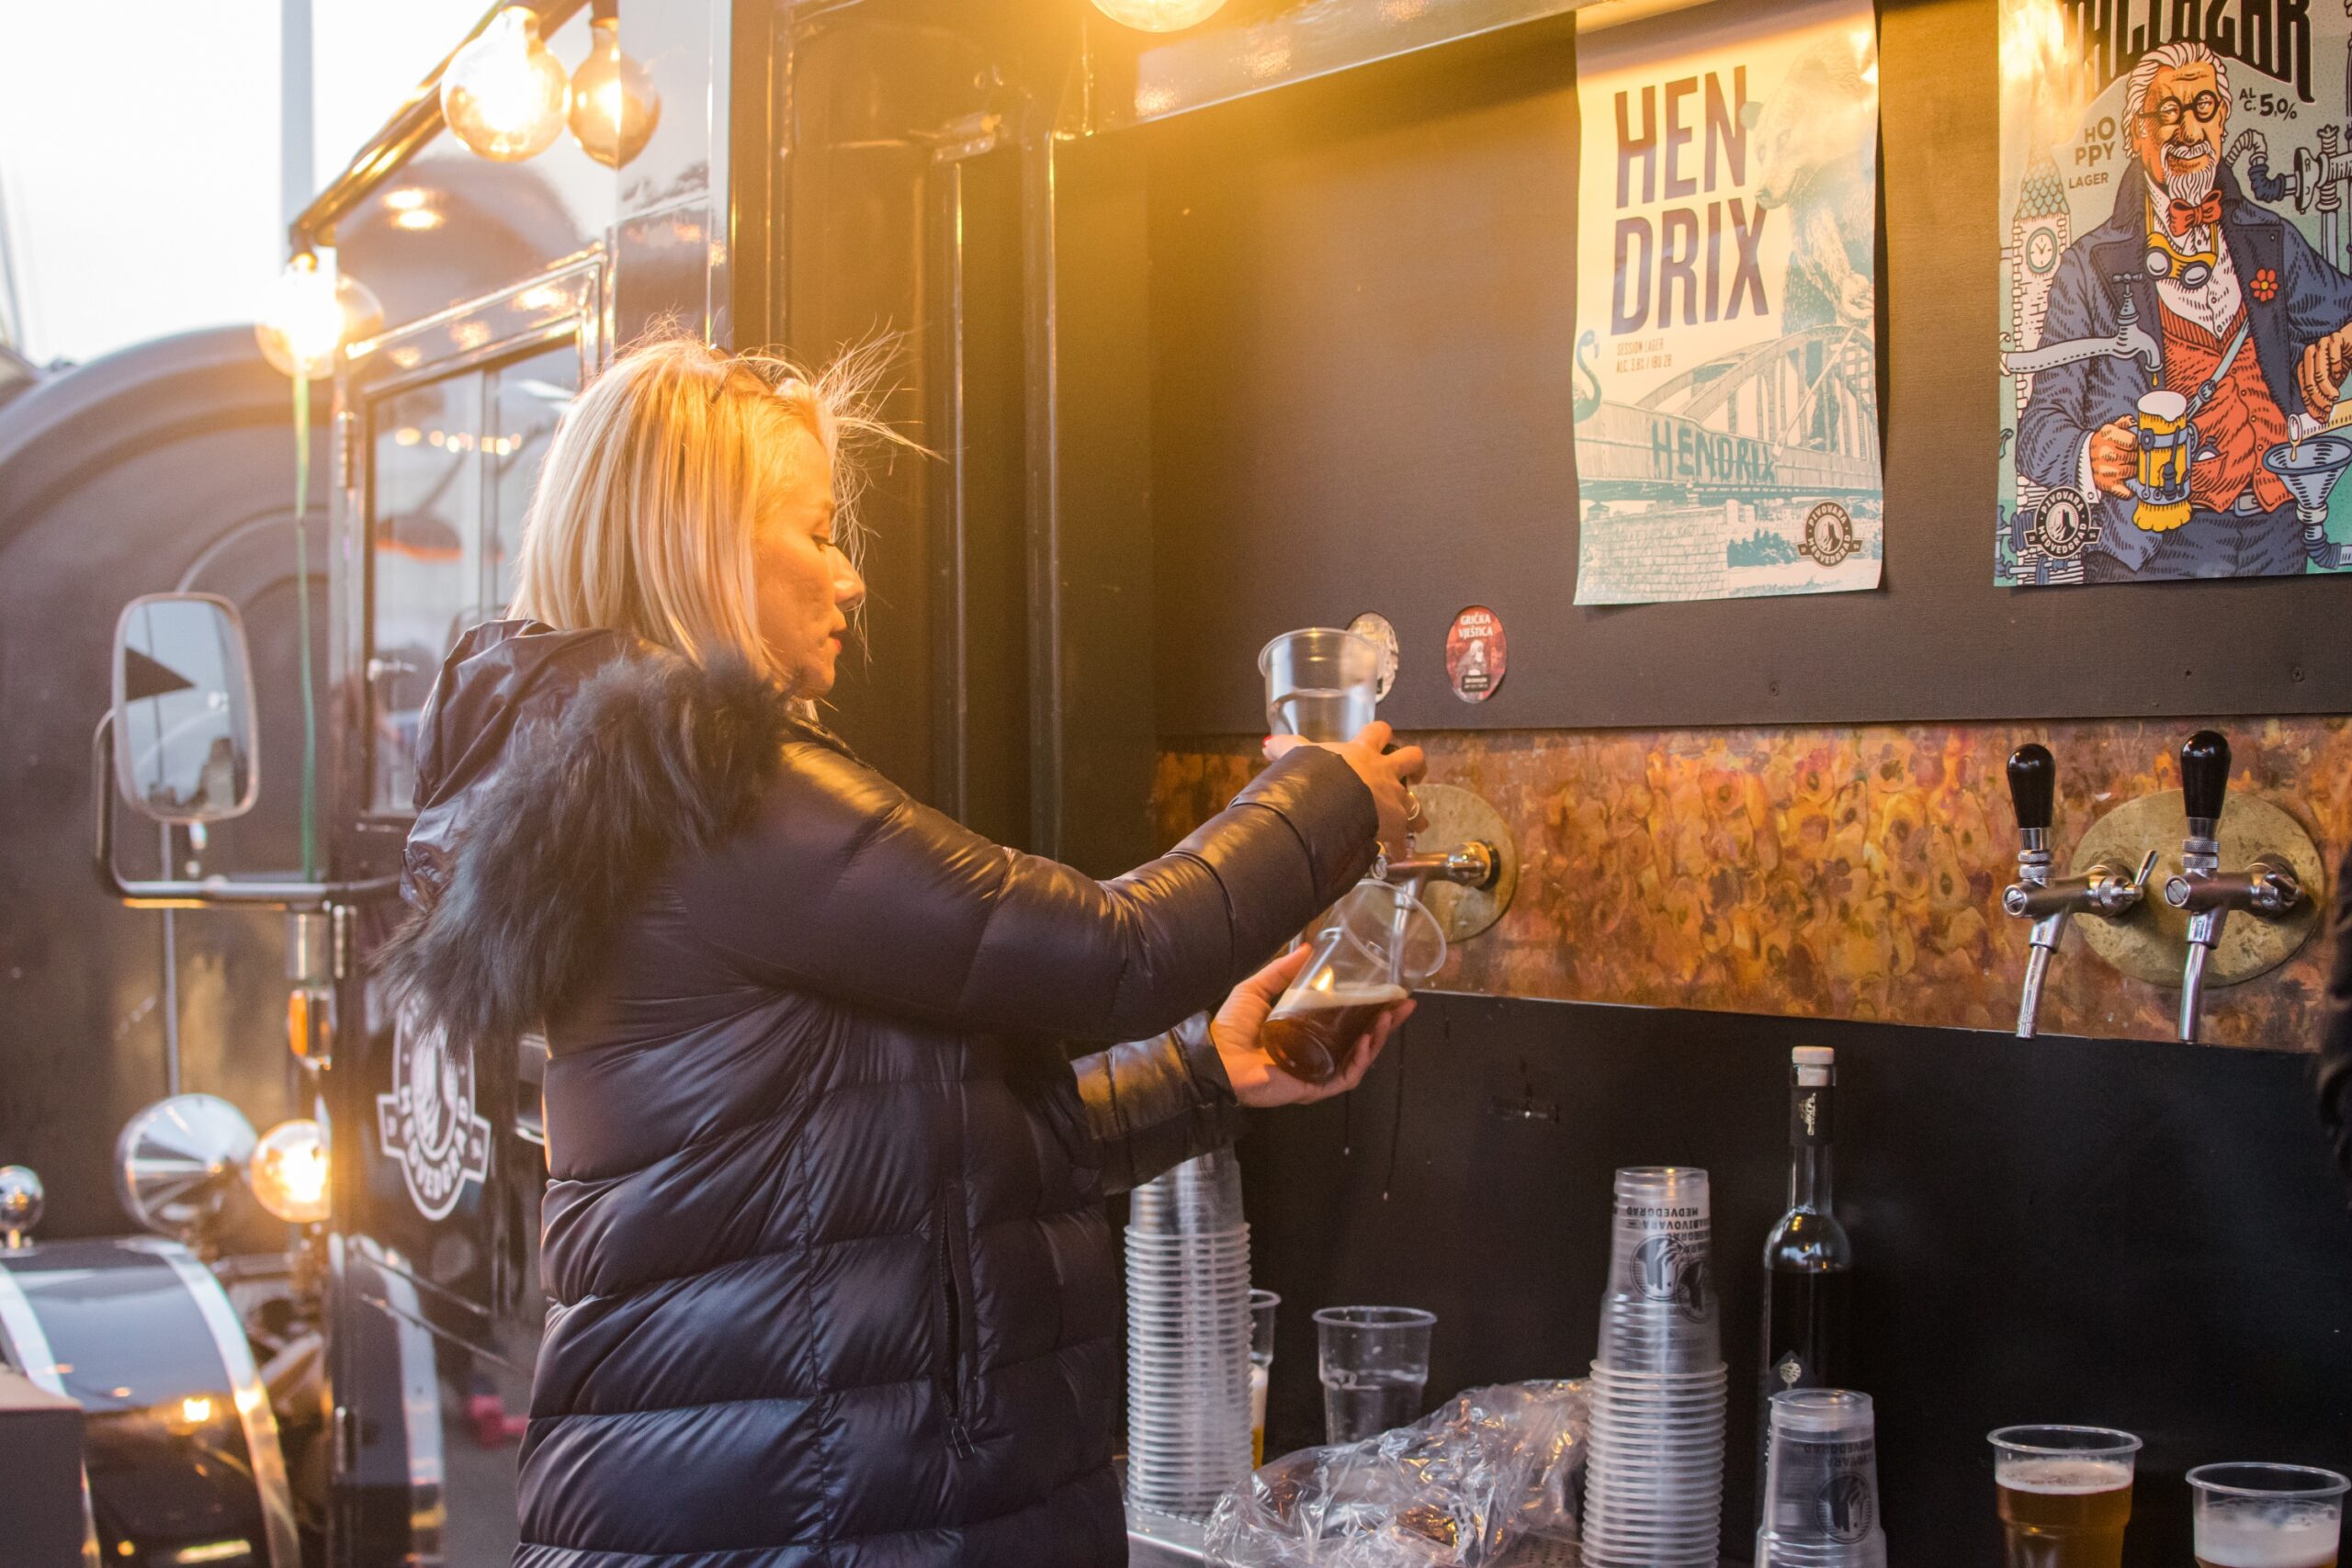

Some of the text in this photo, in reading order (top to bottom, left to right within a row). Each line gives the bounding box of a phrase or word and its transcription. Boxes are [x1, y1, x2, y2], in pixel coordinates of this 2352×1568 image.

[2047, 0, 2315, 103] ALAZAR
[2239, 88, 2256, 100] AL
[2244, 100, 2256, 111] C.
[2259, 94, 2298, 120] 5,0%
[1614, 65, 1747, 209] HEN
[2084, 116, 2114, 141] HO
[2075, 141, 2115, 167] PPY
[2068, 172, 2109, 189] LAGER
[1611, 197, 1770, 335] DRIX
[1617, 338, 1664, 356] SESSION LAGER
[1652, 420, 1776, 485] HENDRIX
[2041, 491, 2085, 513] PIVOVARA
[1808, 505, 1848, 527] PIVOVARA
[1807, 535, 1851, 564] MEDVEDGRAD
[2038, 523, 2087, 554] MEDVEDGRAD
[1460, 612, 1490, 626] GRIČKA
[1458, 626, 1493, 640] VJEŠTICA
[1625, 1206, 1699, 1217] MEDVEDGRAD
